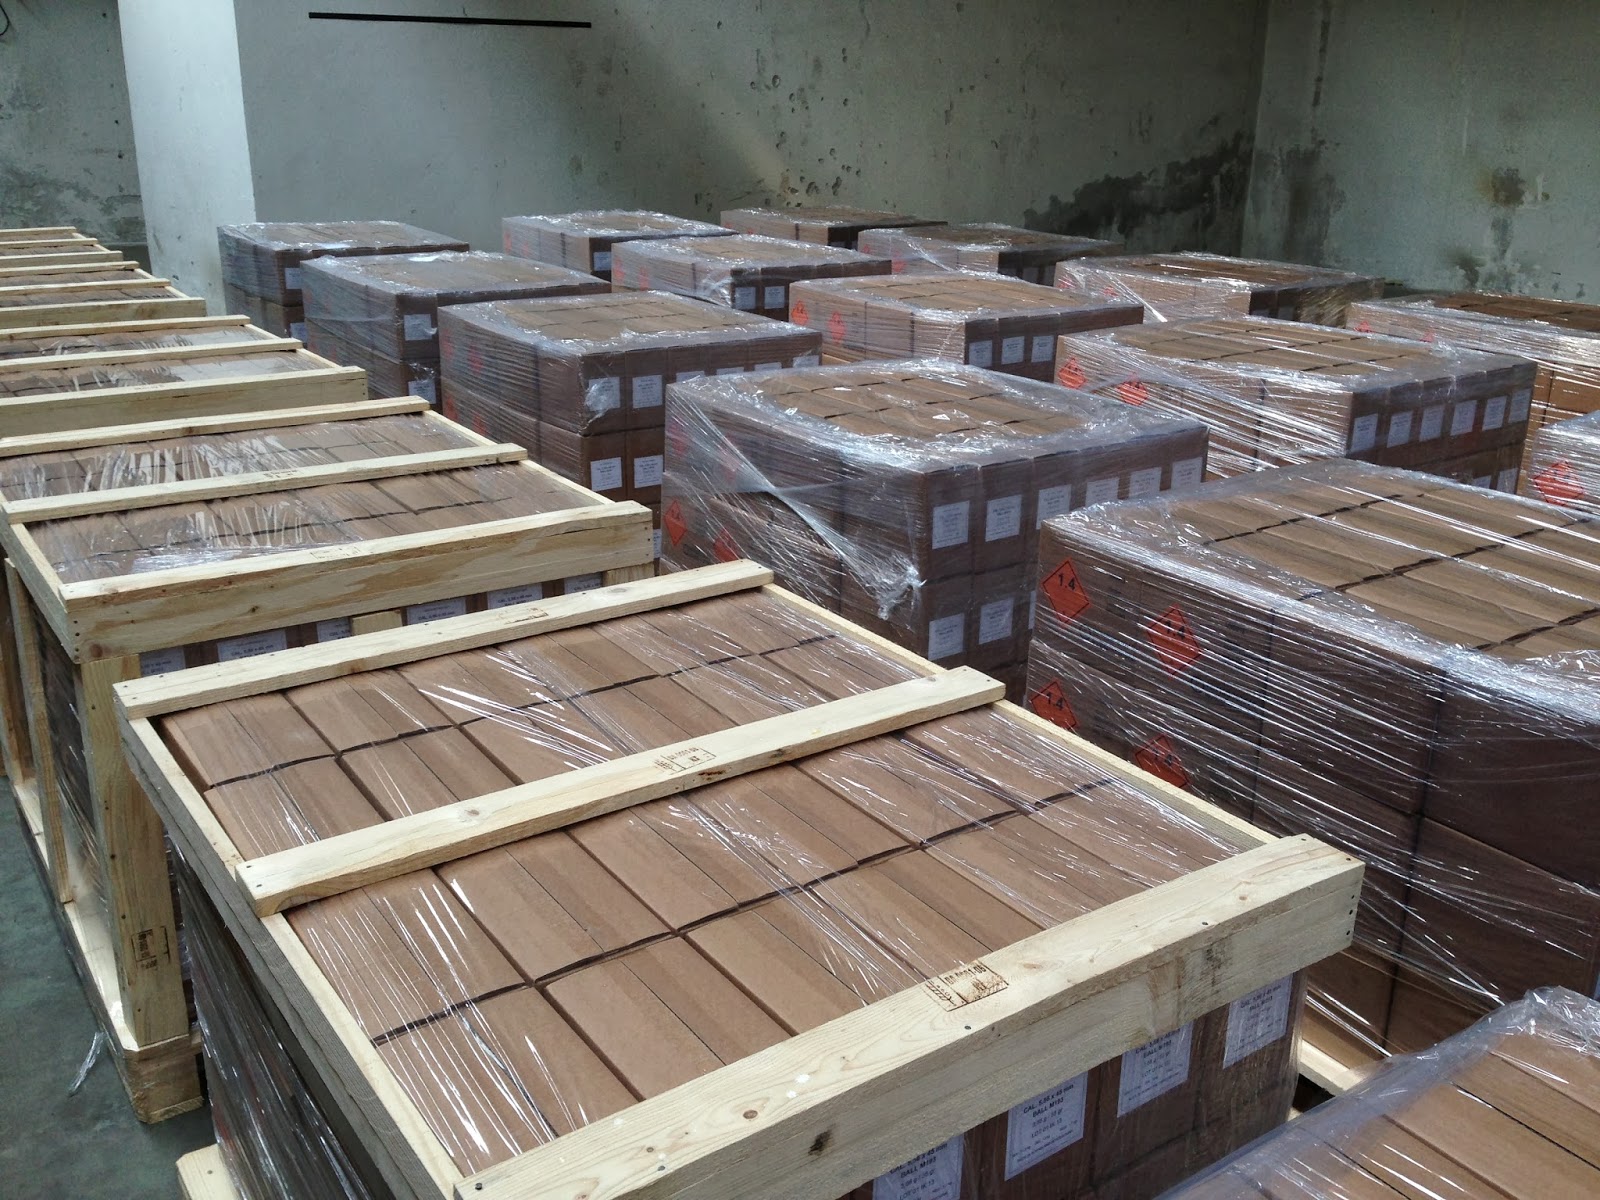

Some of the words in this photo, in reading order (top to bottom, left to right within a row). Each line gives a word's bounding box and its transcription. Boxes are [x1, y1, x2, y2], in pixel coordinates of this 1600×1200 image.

[1058, 573, 1076, 590] 1.4
[1166, 620, 1186, 640] 1.4
[1046, 692, 1063, 710] 1.4
[1023, 1104, 1038, 1114] CAL.
[1032, 1106, 1048, 1118] BALL
[900, 1166, 918, 1178] BALL
[920, 1156, 937, 1169] M193
